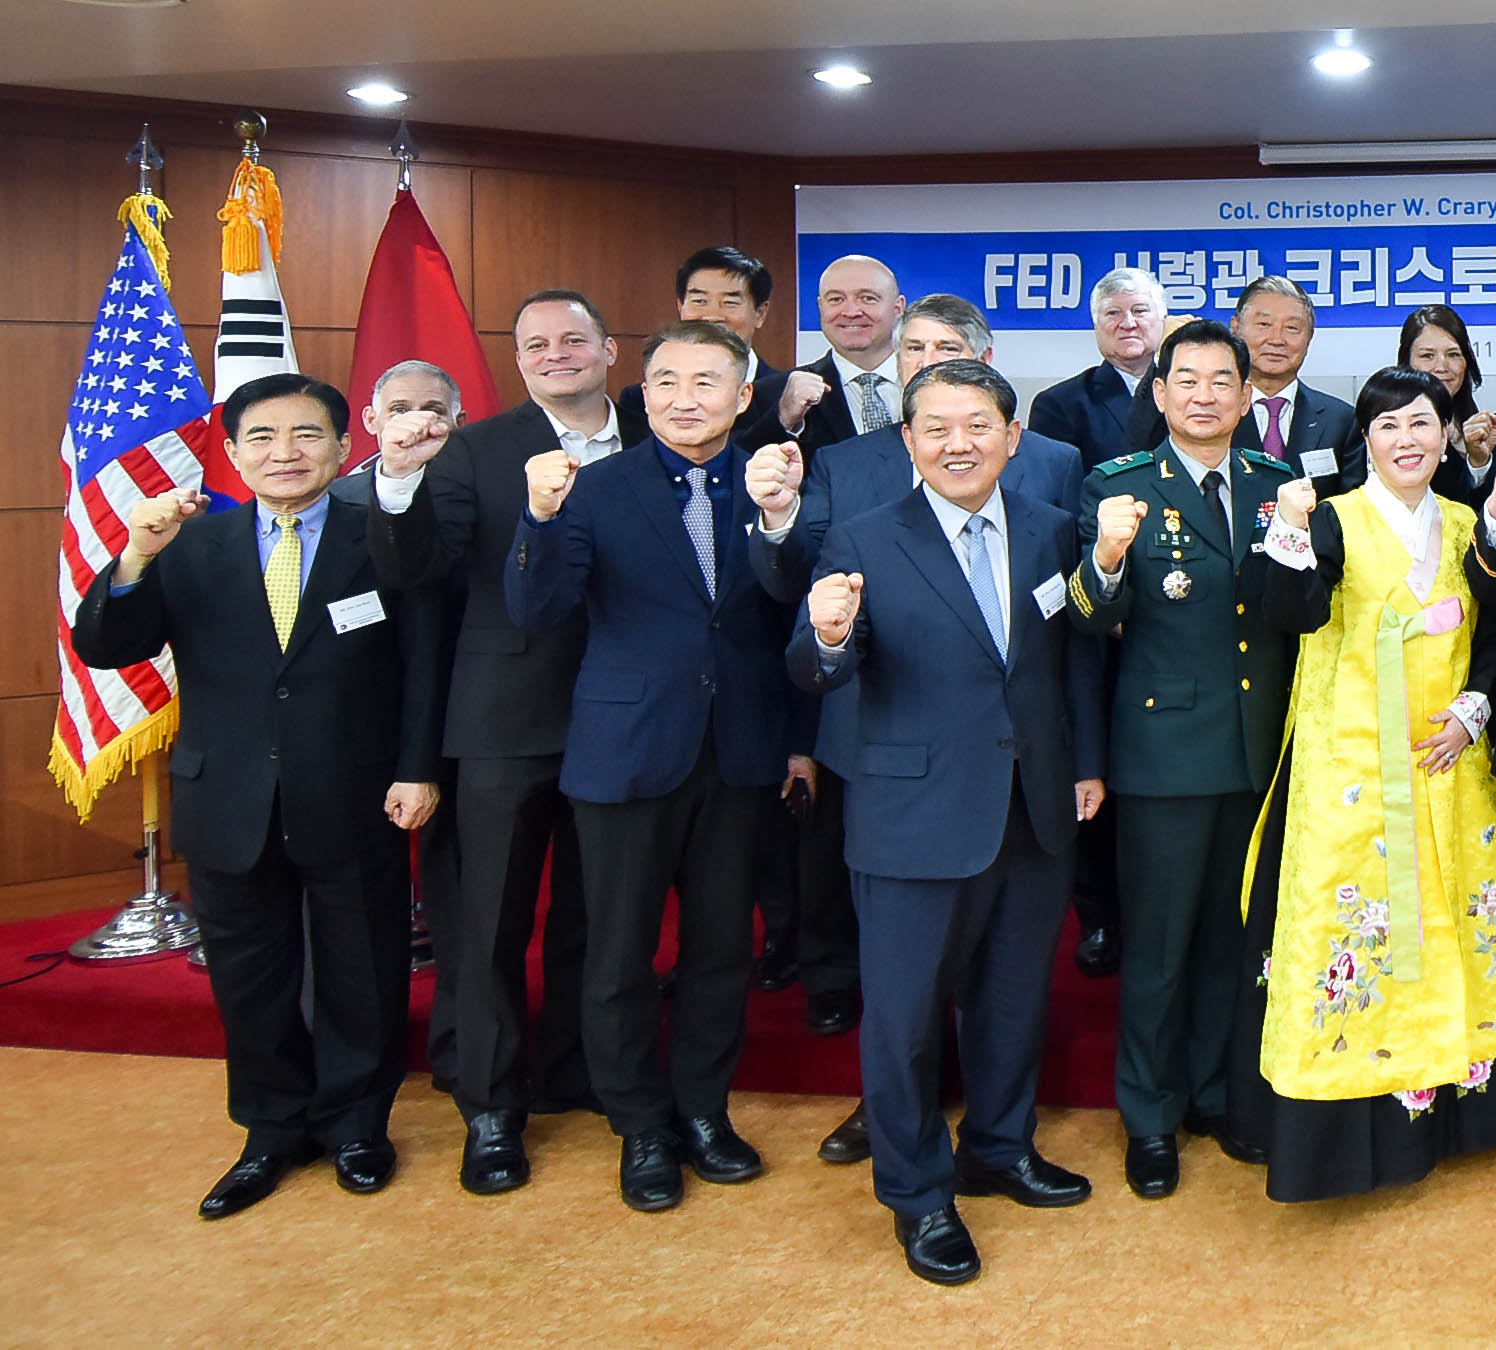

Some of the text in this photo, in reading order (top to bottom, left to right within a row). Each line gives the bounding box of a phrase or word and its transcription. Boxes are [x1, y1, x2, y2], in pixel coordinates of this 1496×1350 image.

[1219, 202, 1260, 220] Col.
[1266, 199, 1397, 222] Christopher
[1402, 198, 1430, 217] W.
[984, 253, 1082, 309] FED
